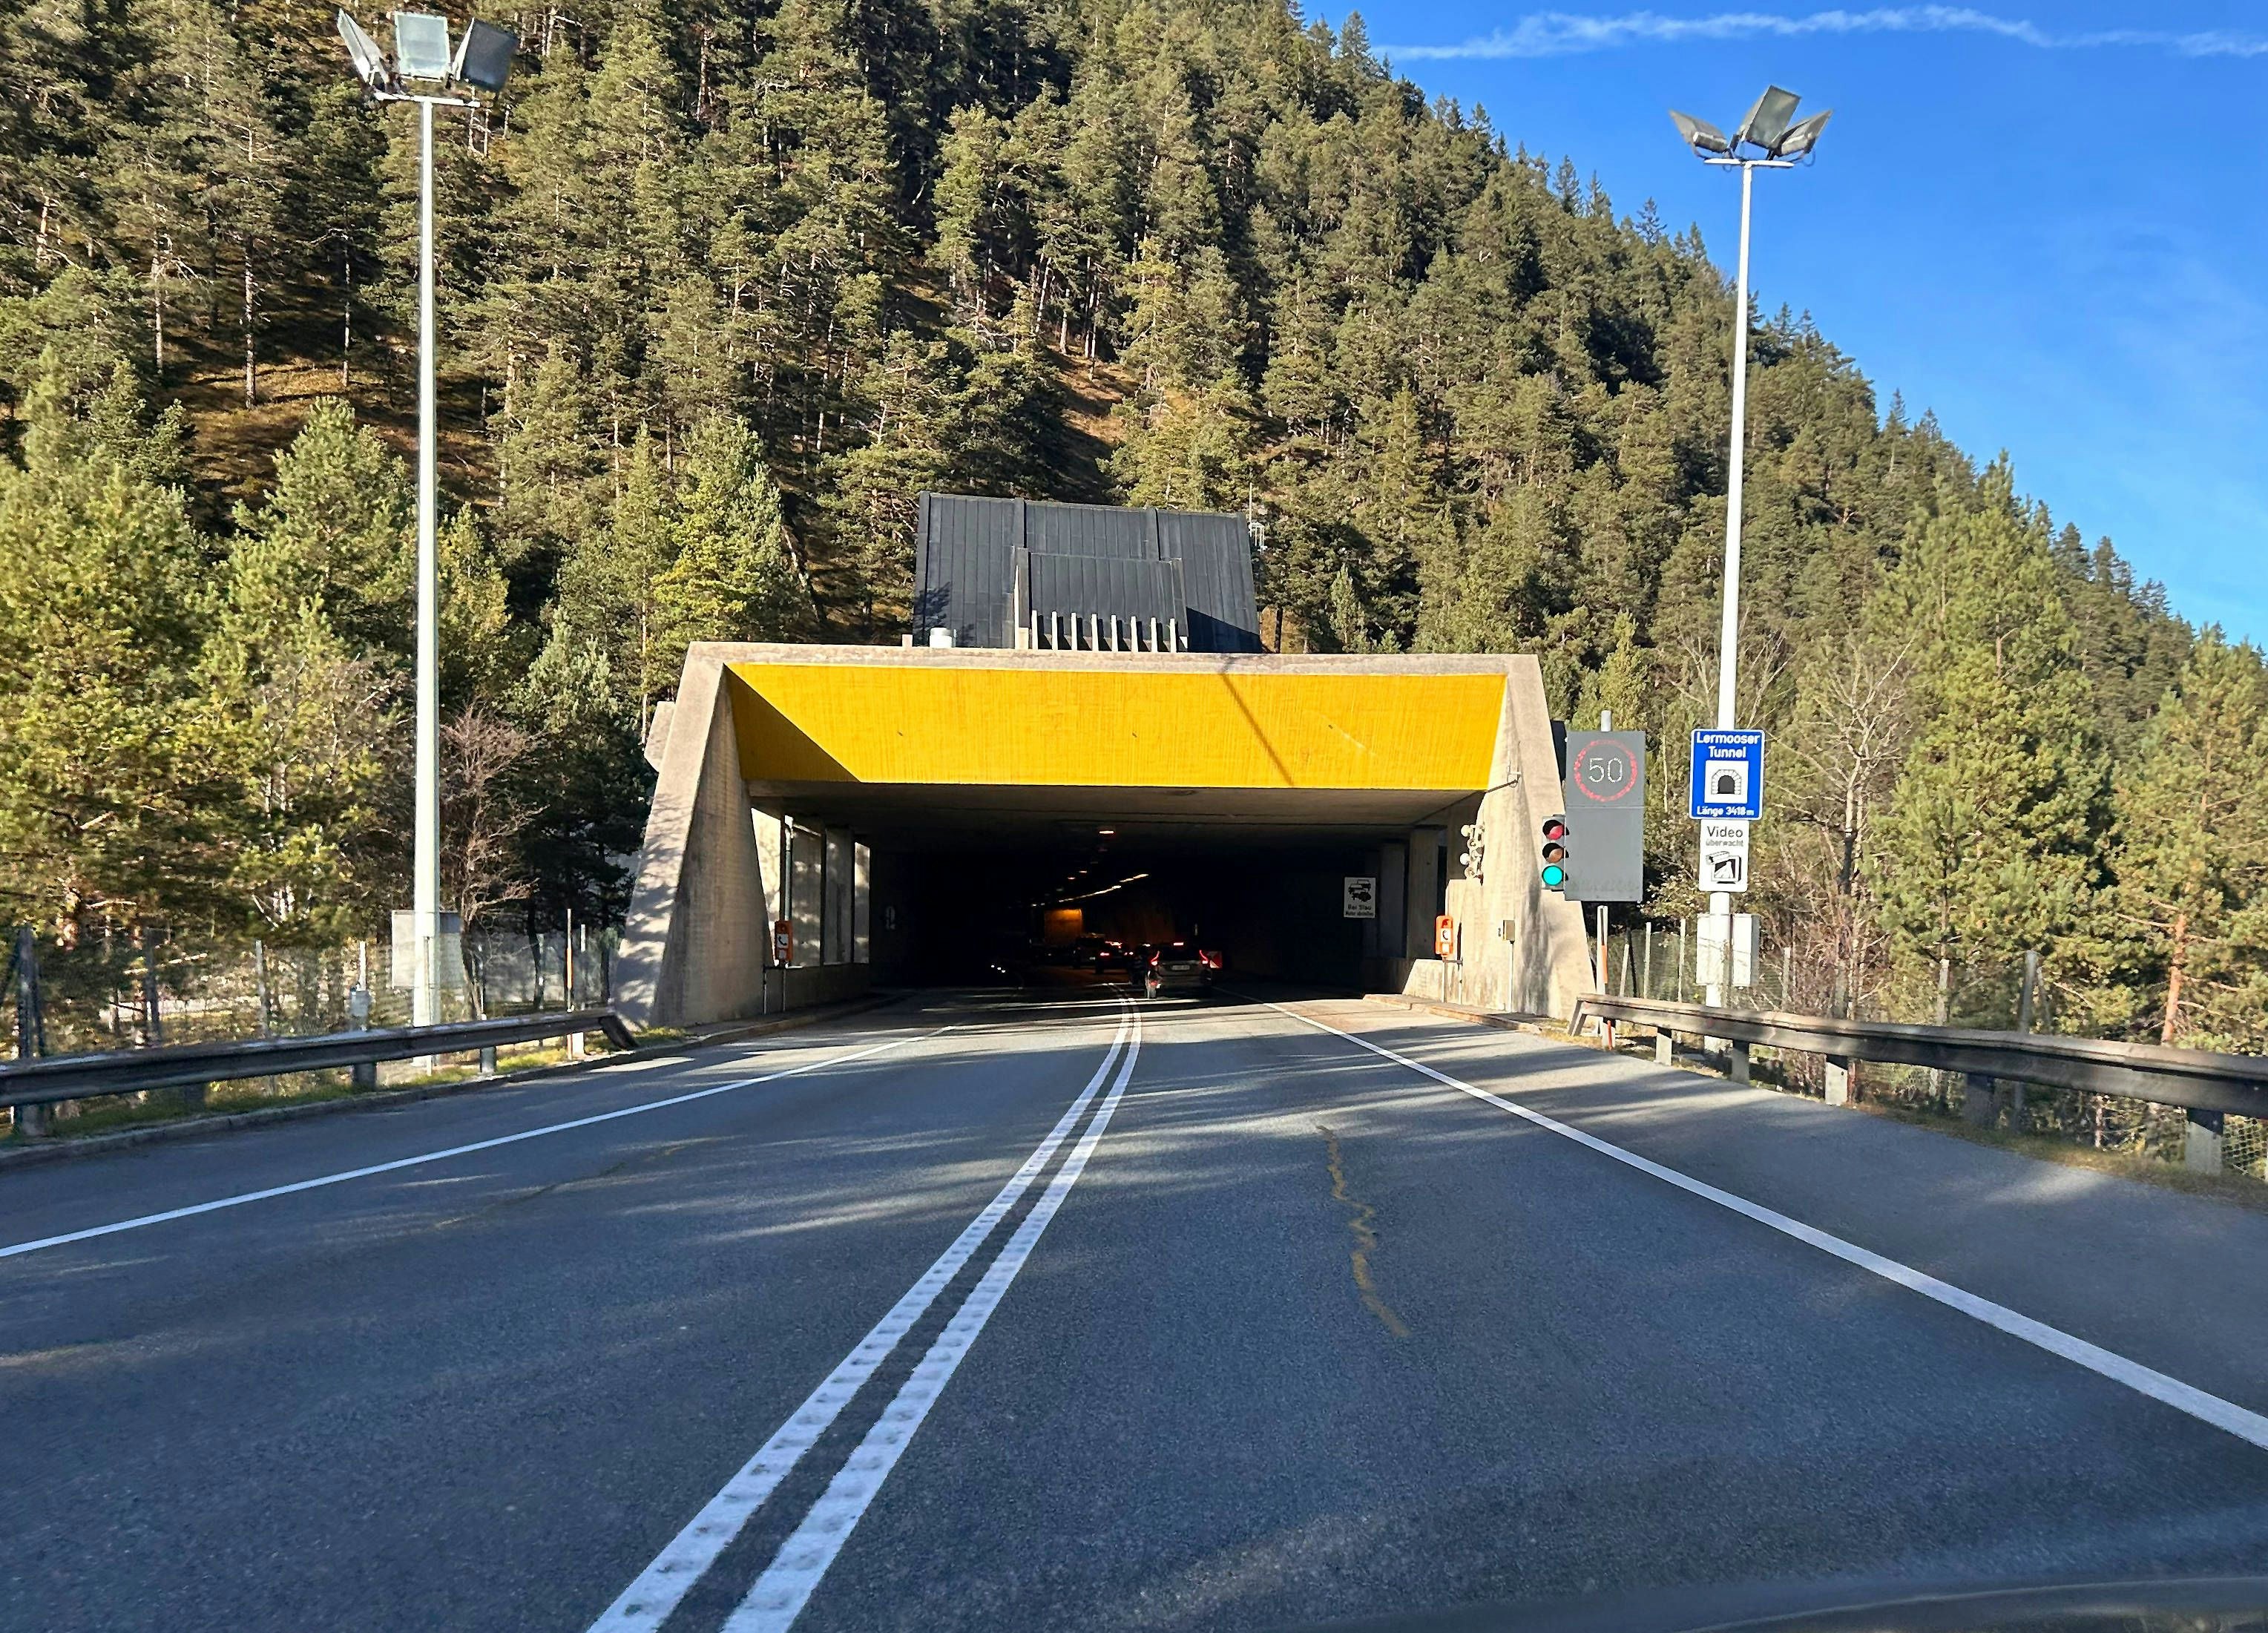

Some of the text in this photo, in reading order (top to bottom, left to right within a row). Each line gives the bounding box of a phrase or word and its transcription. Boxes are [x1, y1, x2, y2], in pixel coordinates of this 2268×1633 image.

[1697, 732, 1760, 744] Lermooser
[1709, 746, 1746, 758] Tunnel
[1588, 758, 1623, 783] 50
[1697, 806, 1723, 817] Länge
[1706, 826, 1743, 838] Video
